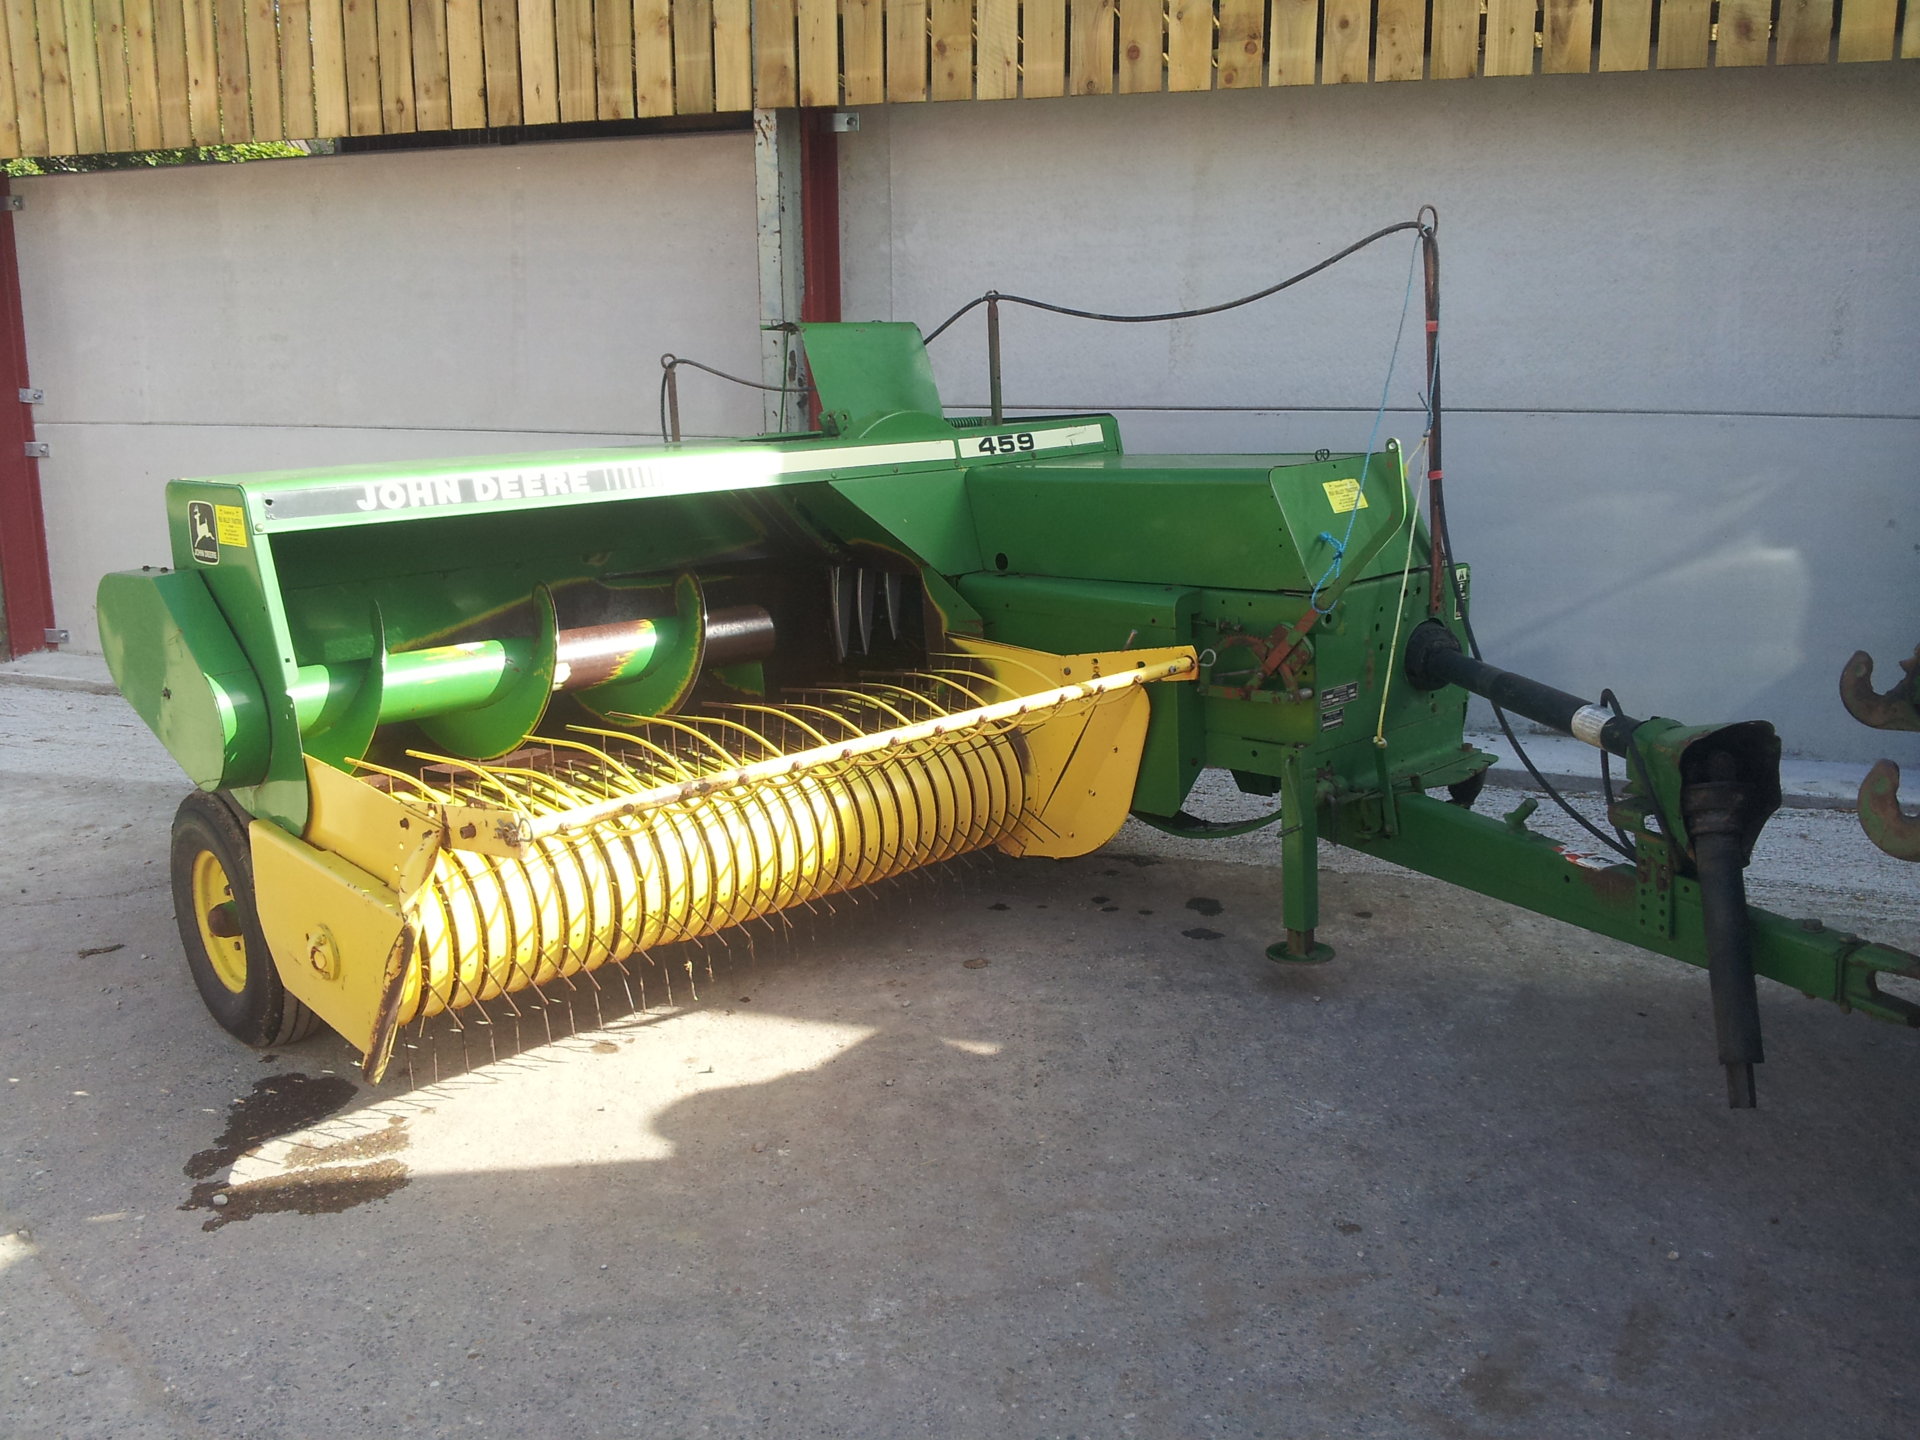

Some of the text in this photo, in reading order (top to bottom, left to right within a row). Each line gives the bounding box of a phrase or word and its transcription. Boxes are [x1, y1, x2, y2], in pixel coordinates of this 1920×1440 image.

[978, 433, 1035, 455] 459
[356, 470, 591, 511] JOHN DEERE
